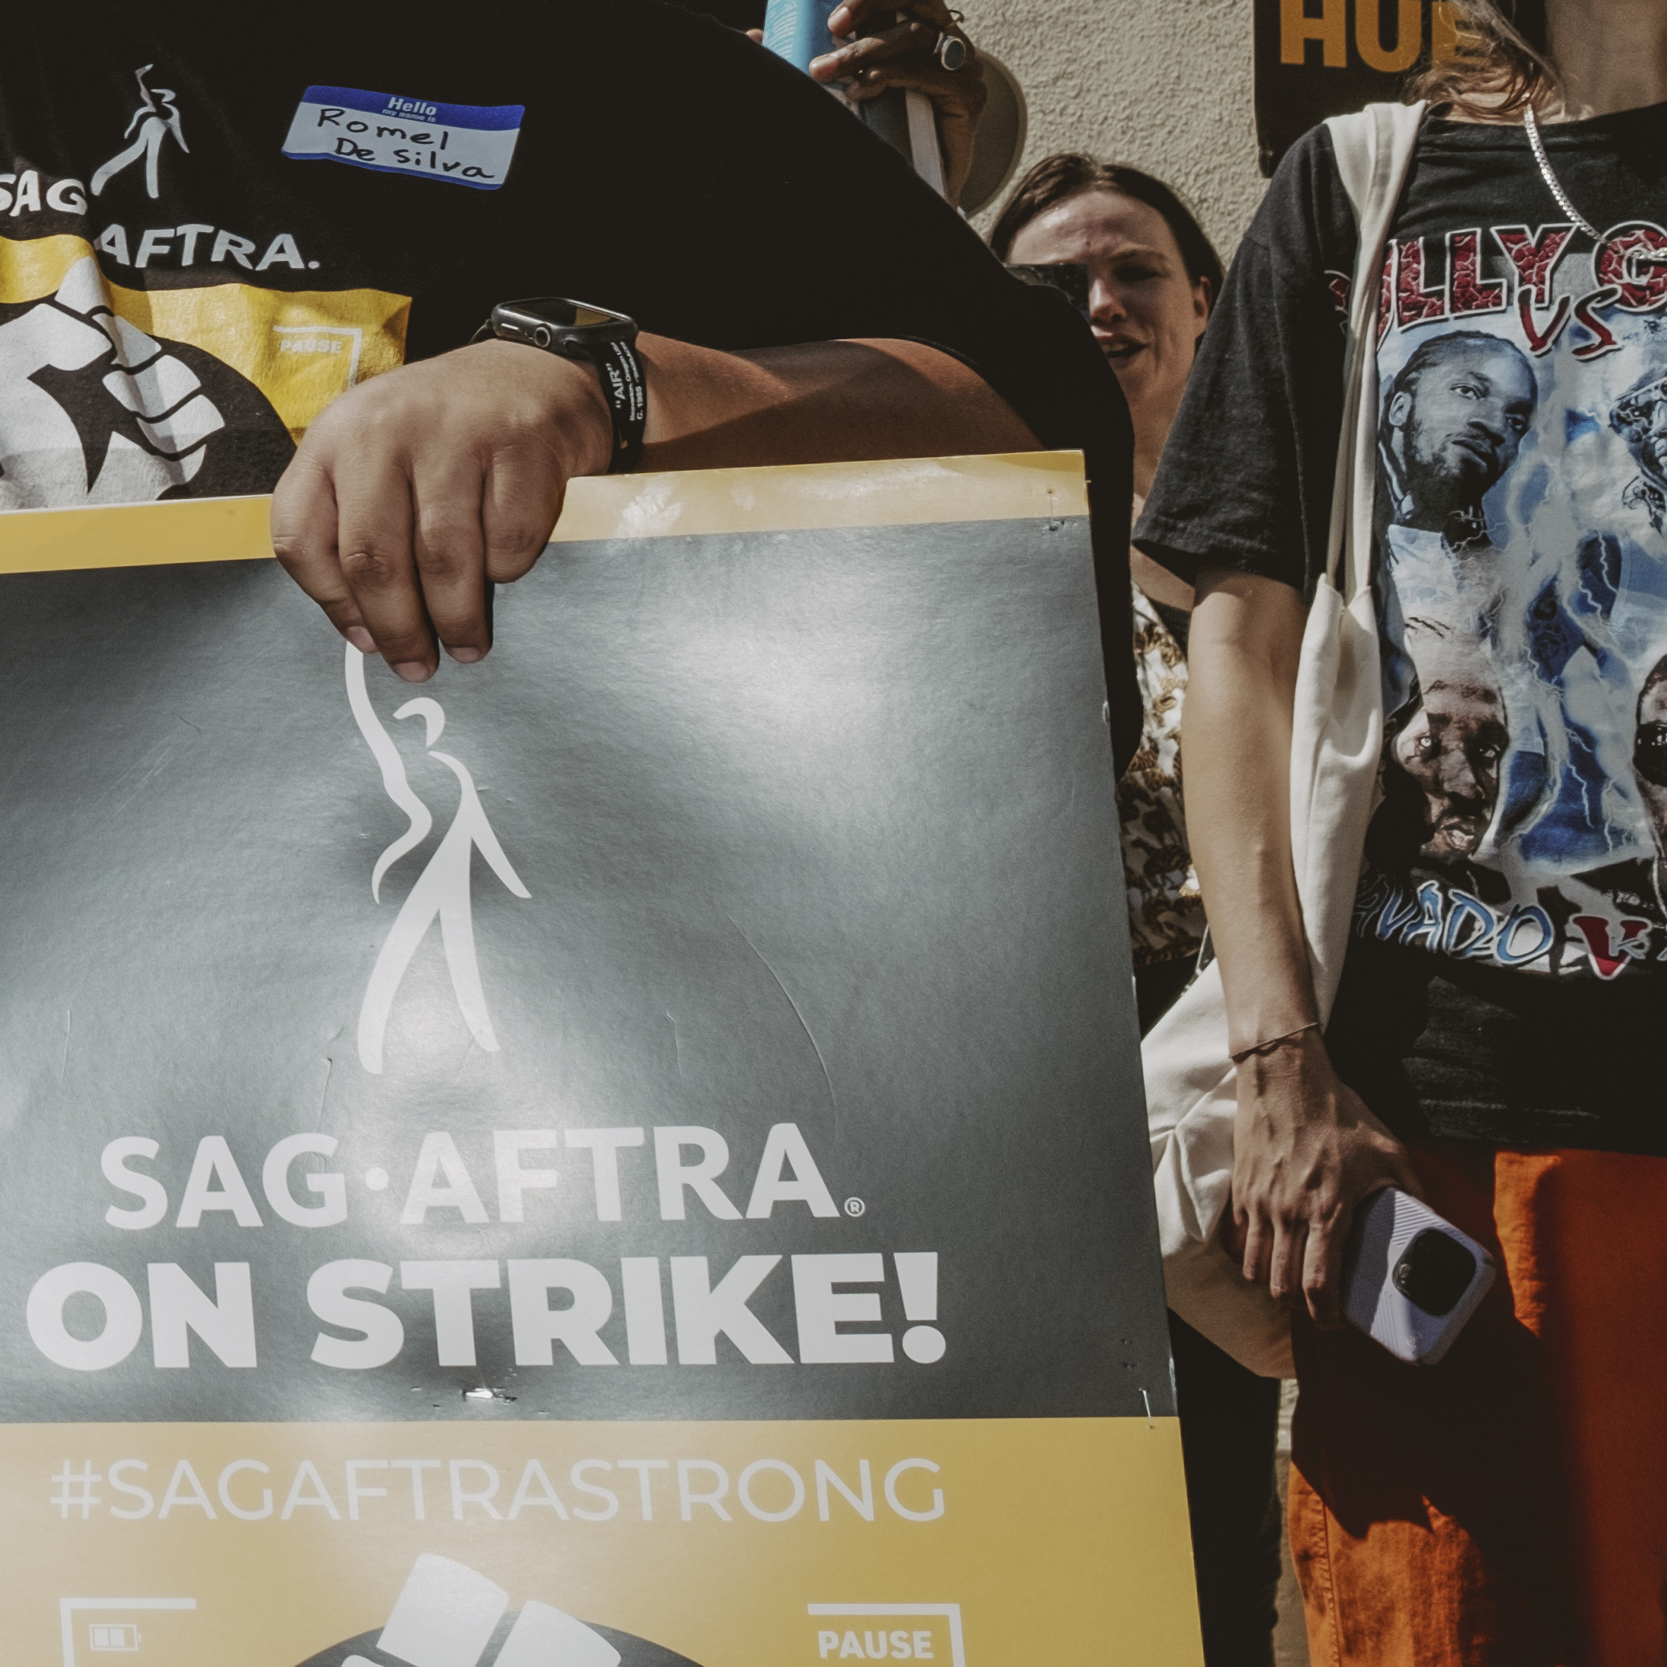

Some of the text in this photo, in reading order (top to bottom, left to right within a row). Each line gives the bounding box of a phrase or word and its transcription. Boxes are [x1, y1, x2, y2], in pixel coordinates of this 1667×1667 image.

[388, 97, 437, 116] Hello
[317, 108, 449, 150] Romel
[334, 137, 376, 162] De
[280, 339, 343, 354] PAUSE
[26, 1251, 946, 1372] ON STRIKE!
[50, 1456, 946, 1526] #SAGAFTRASTRONG
[817, 1630, 934, 1660] PAUSE
